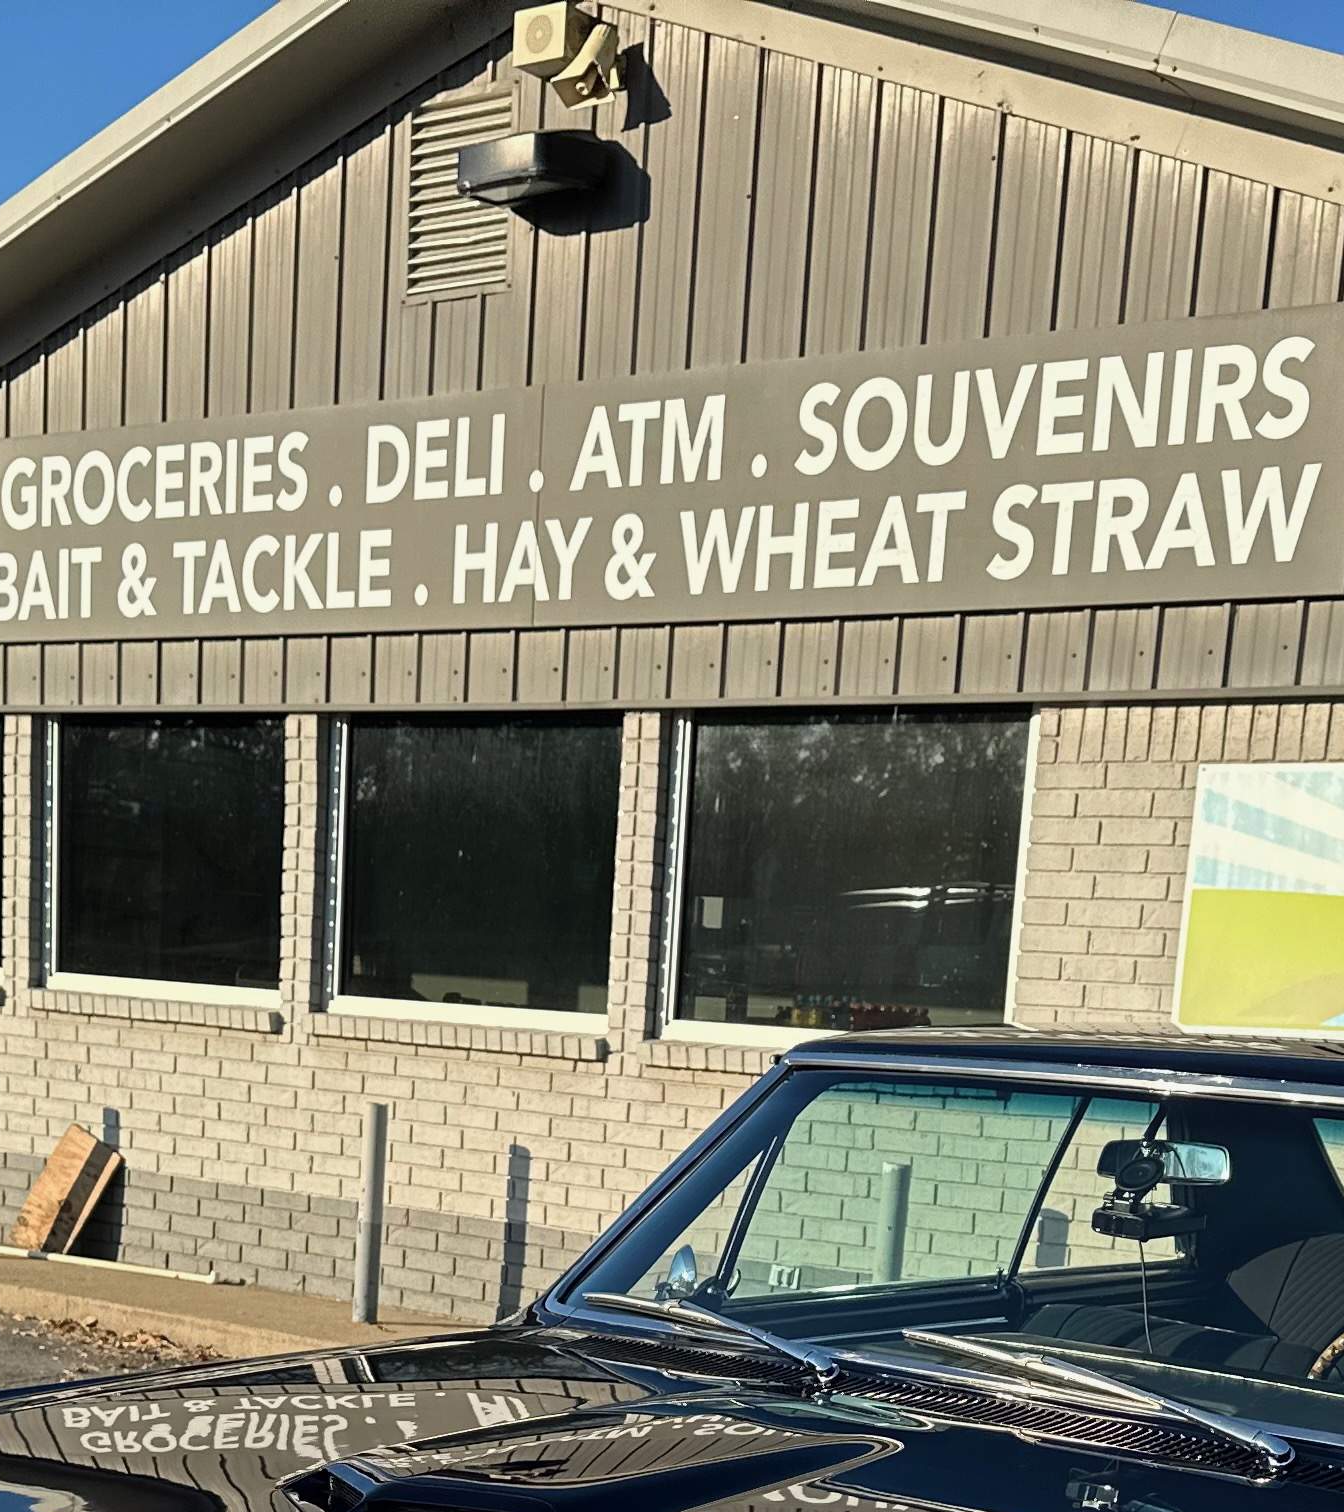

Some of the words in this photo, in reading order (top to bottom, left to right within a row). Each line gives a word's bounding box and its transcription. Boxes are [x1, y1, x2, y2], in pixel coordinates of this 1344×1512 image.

[1, 431, 309, 531] GROCERIES
[365, 413, 507, 505] DELI
[569, 395, 725, 492] ATM
[794, 336, 1316, 476] SOUVENIRS
[117, 543, 157, 618] &
[173, 529, 392, 615] TACKLE
[452, 517, 593, 605] HAY
[604, 512, 656, 601] &
[680, 489, 967, 596] WHEAT
[985, 463, 1322, 581] STRAW
